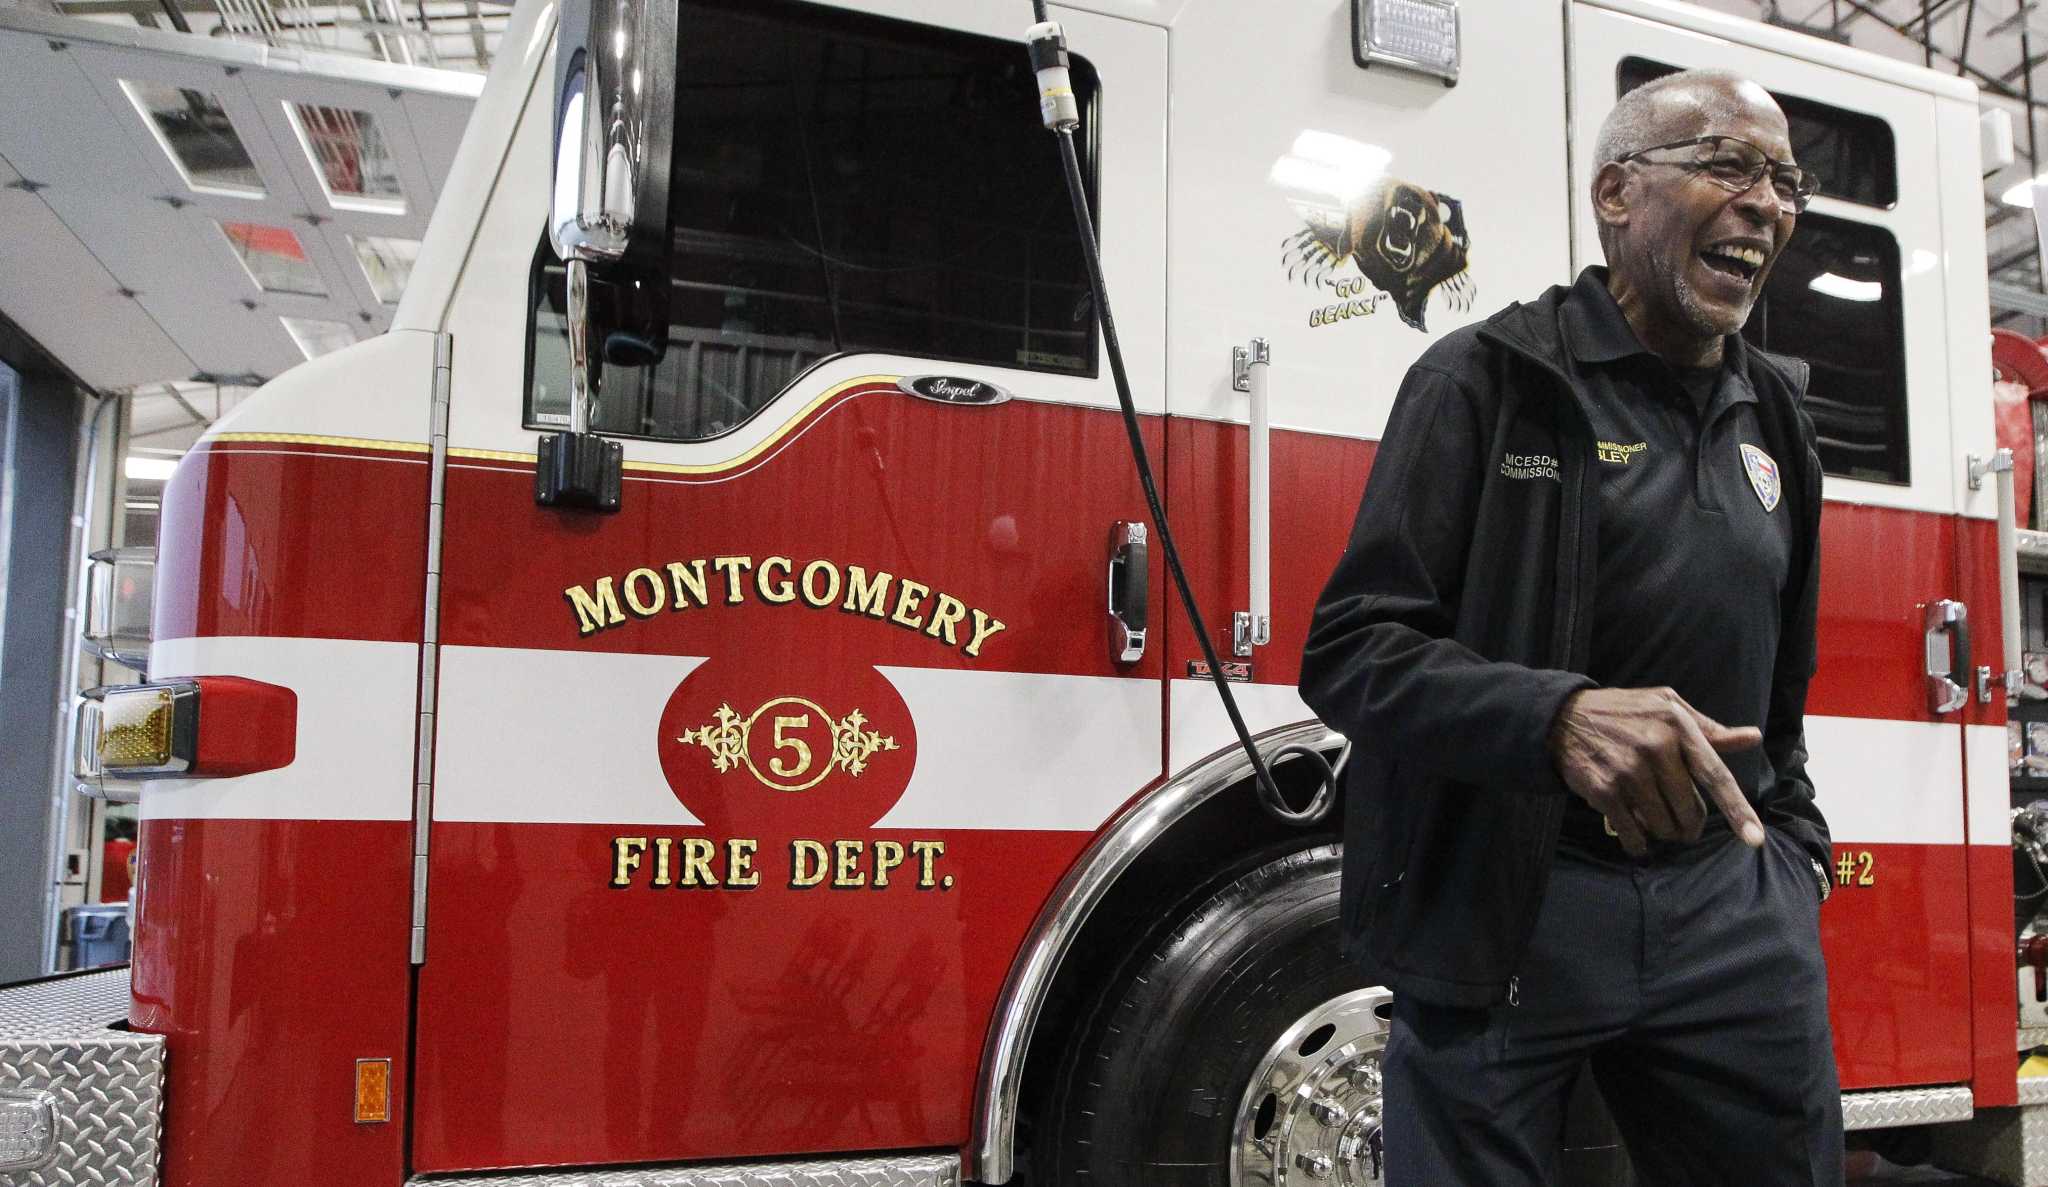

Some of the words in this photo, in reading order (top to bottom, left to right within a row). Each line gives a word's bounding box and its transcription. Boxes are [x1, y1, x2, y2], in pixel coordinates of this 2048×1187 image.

[1597, 440, 1648, 452] MMISSIONER
[1500, 463, 1562, 482] COMMISSION
[563, 555, 1007, 658] MONTGOMERY
[769, 714, 812, 778] 5
[611, 836, 760, 889] FIRE
[791, 839, 955, 890] DEPT.
[1836, 850, 1875, 887] #2
